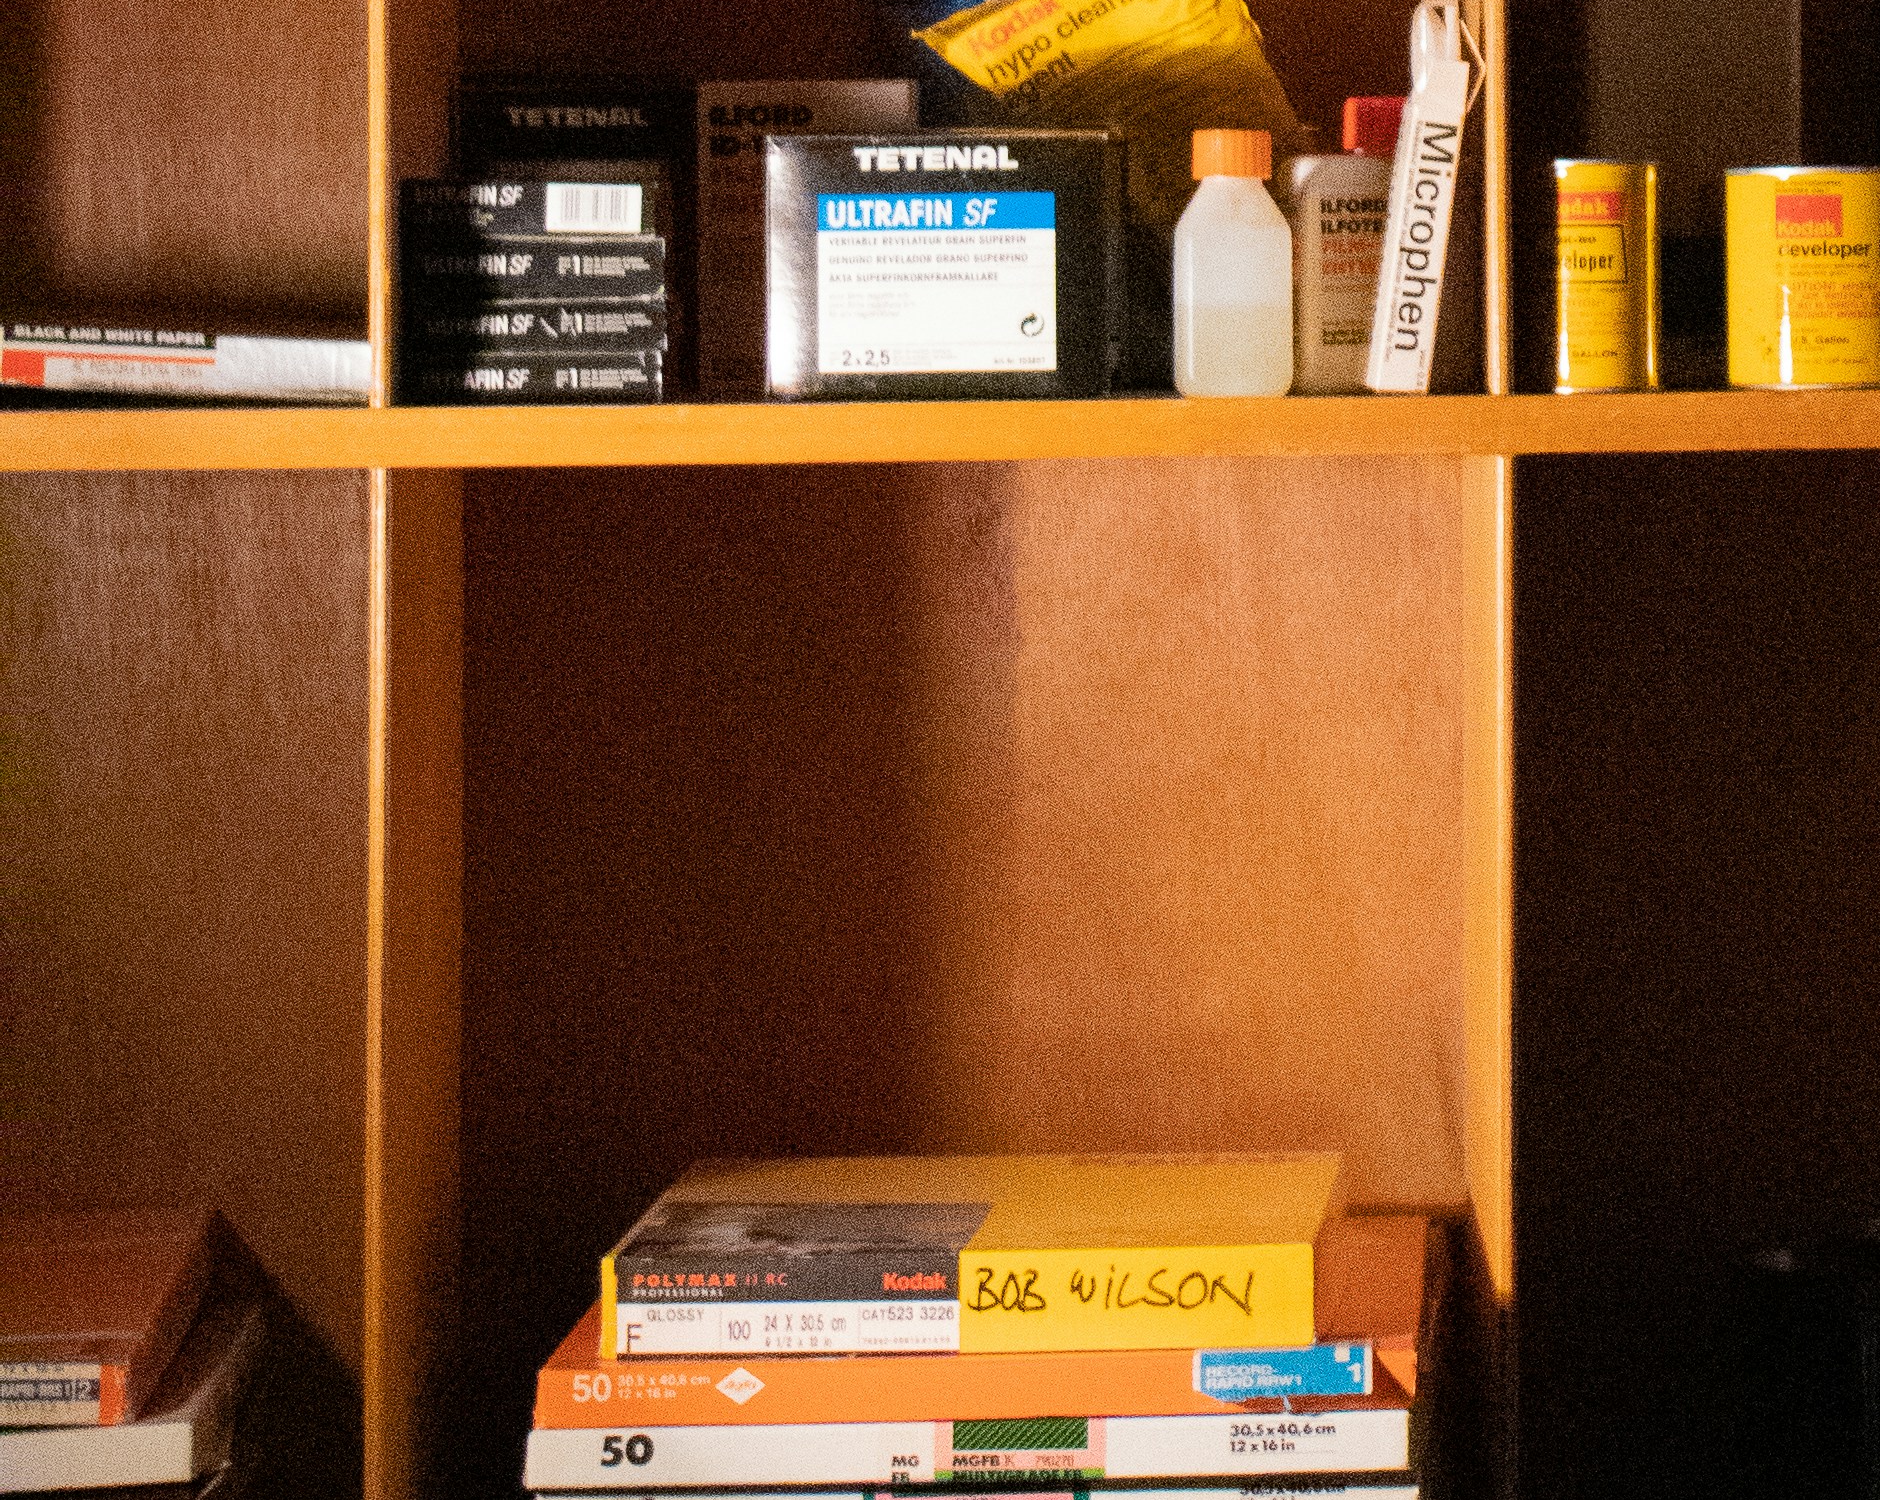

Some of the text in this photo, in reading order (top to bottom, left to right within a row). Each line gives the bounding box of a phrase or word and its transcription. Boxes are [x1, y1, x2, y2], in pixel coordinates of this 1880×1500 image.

[985, 34, 1051, 85] hypo
[506, 106, 649, 127] TETENAL
[709, 104, 814, 127] ILFORD
[854, 146, 1019, 171] TETENAL
[826, 198, 998, 229] ULTRAFIN SF
[1559, 197, 1610, 217] odak
[1394, 121, 1457, 351] Microphen
[1777, 219, 1836, 237] Kodak
[842, 349, 852, 367] 2
[864, 349, 891, 369] 2,5
[633, 1273, 737, 1288] POLYMAX
[765, 1272, 789, 1286] RC
[883, 1272, 947, 1292] Kodak
[967, 1267, 1046, 1313] BOB
[646, 1308, 705, 1322] GLOSSY
[626, 1323, 643, 1355] F
[727, 1320, 752, 1342] 100
[1347, 1362, 1362, 1384] 1
[572, 1373, 612, 1403] 50
[1230, 1423, 1264, 1438] 30,5
[1266, 1426, 1275, 1436] x
[1315, 1423, 1337, 1435] cm
[600, 1433, 654, 1468] 50
[1230, 1438, 1296, 1453] 12 x 16 in
[891, 1454, 920, 1468] MG
[952, 1454, 1001, 1468] MGFB
